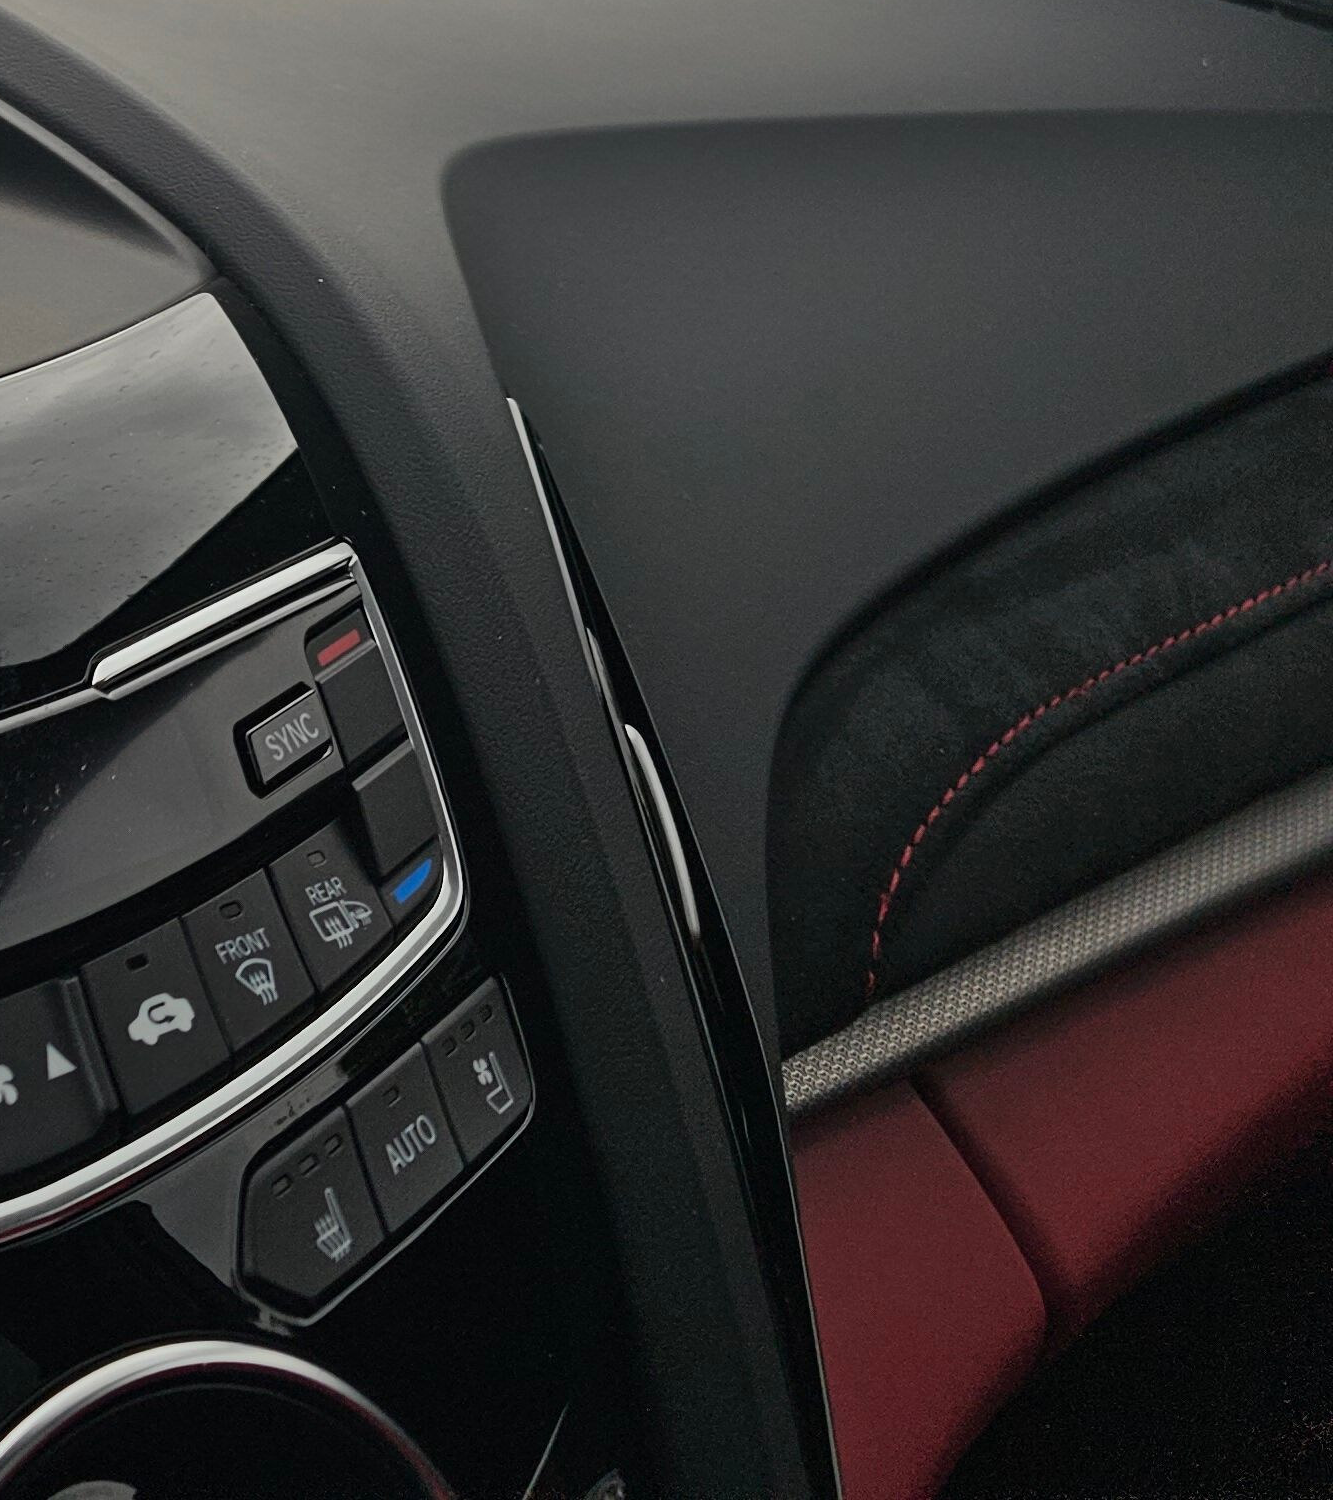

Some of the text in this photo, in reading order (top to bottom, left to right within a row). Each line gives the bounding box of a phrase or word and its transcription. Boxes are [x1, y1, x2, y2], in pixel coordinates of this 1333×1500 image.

[265, 713, 320, 764] SYNC
[305, 876, 346, 906] REAR
[214, 928, 271, 964] FRONT
[386, 1115, 438, 1173] AUTO
